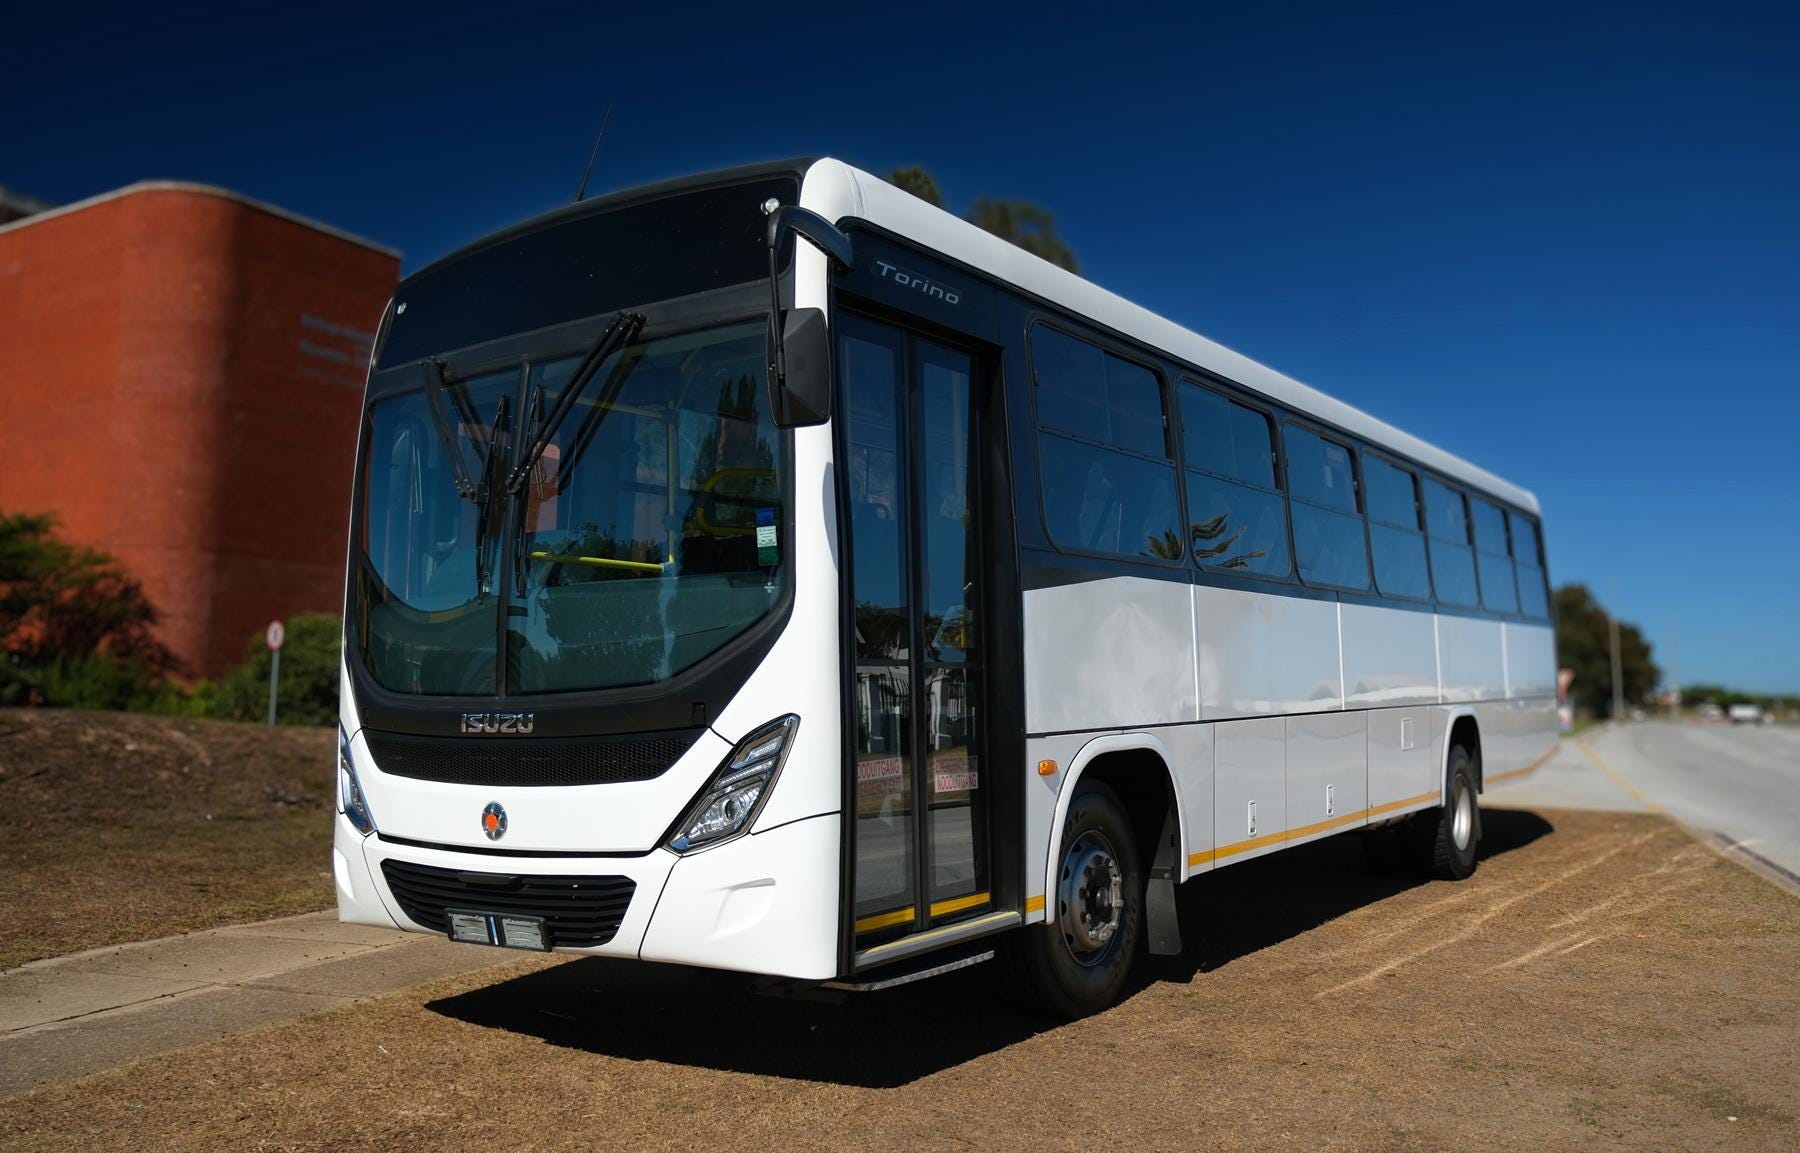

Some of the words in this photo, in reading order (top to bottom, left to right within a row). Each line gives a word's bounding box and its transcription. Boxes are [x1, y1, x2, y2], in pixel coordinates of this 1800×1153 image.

[876, 260, 960, 305] Torino
[460, 712, 535, 734] ISUZU
[937, 773, 977, 791] NOODUITGANG
